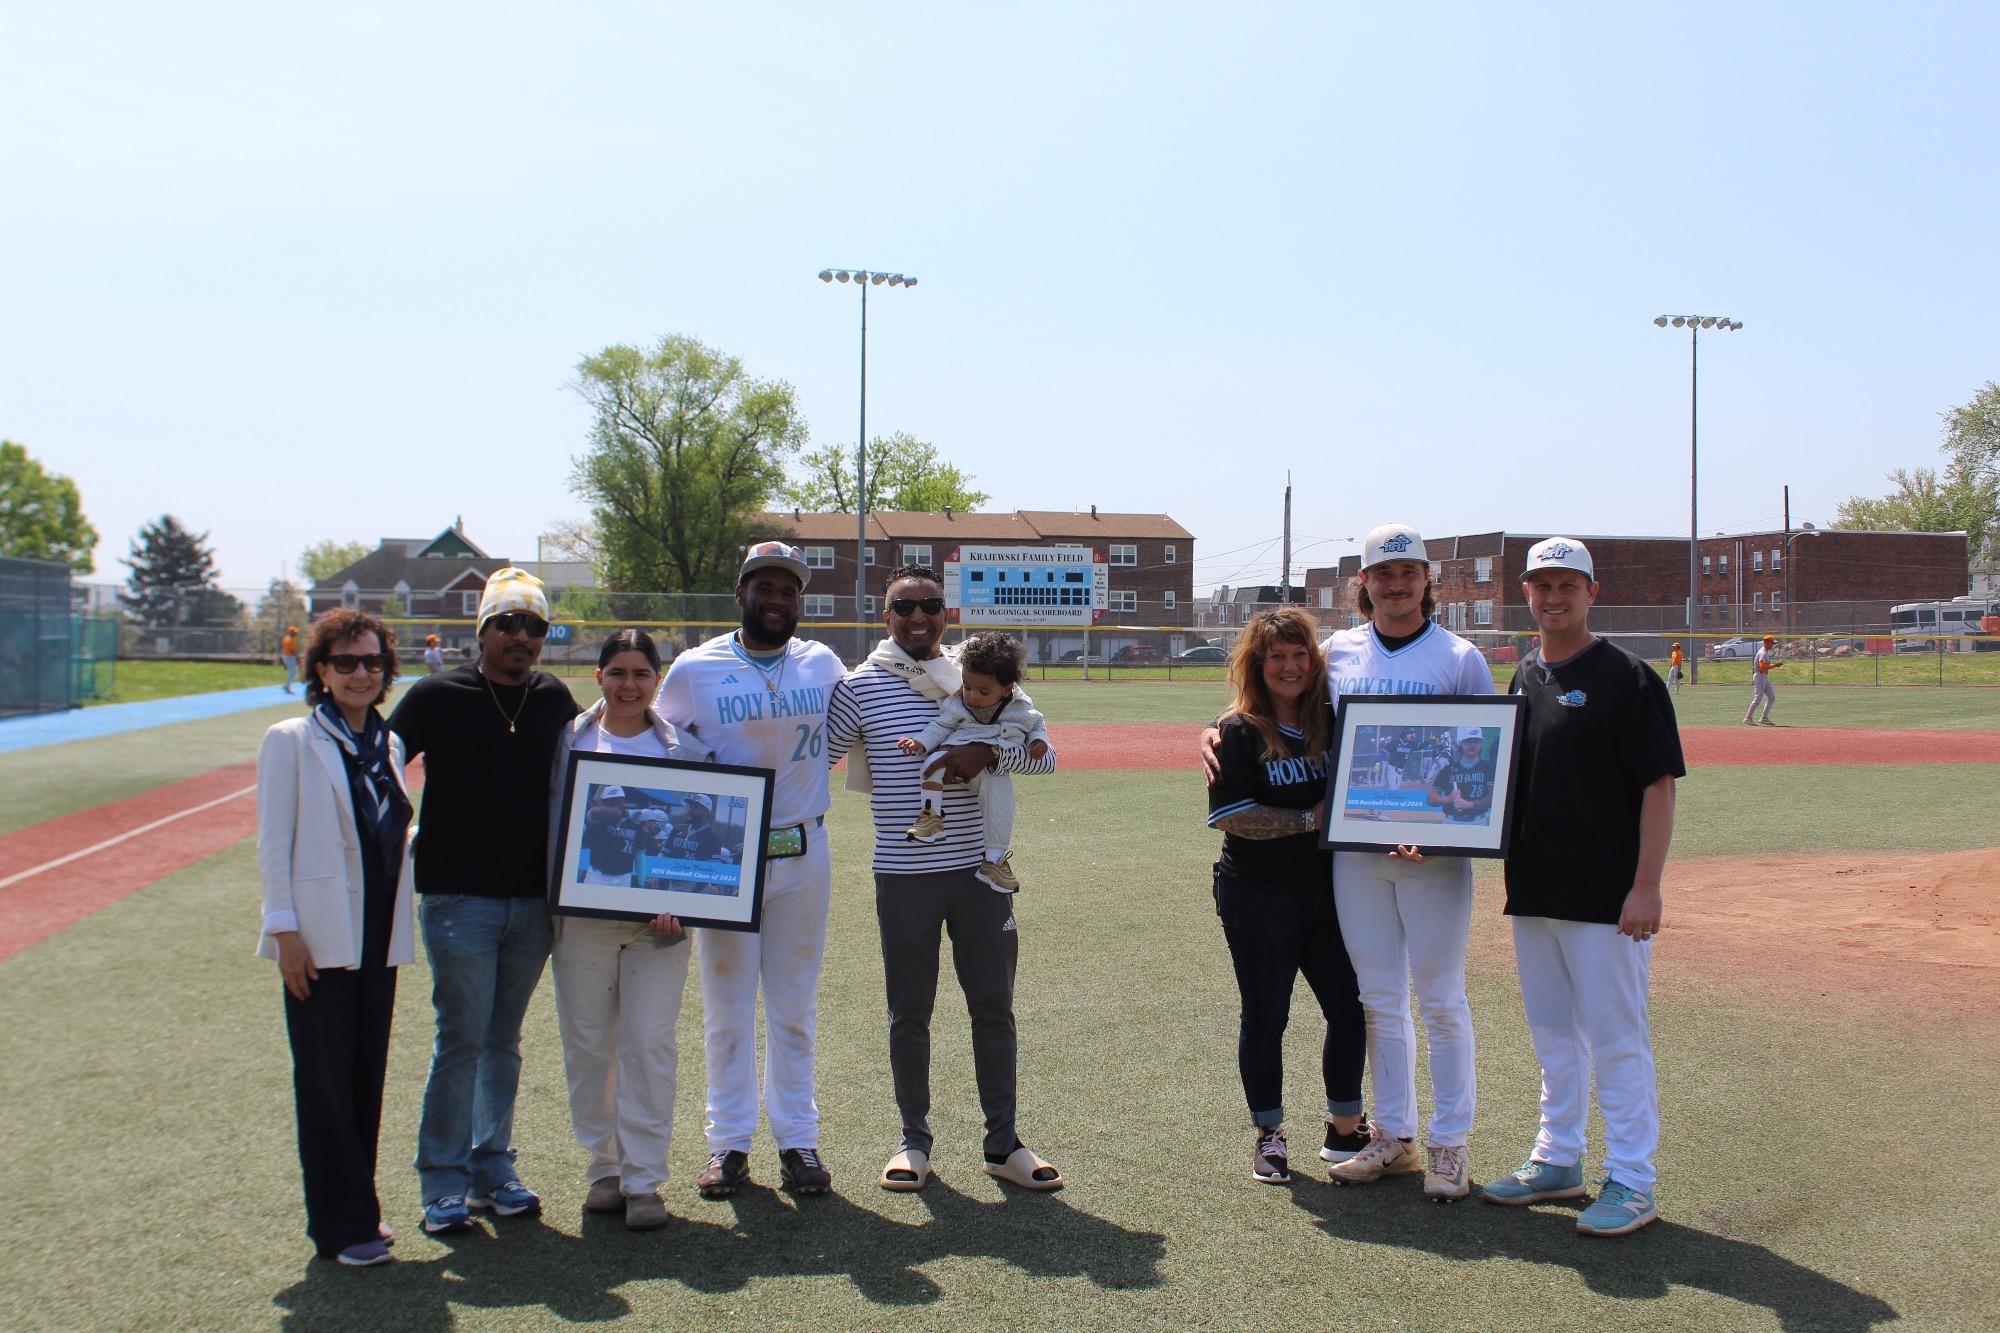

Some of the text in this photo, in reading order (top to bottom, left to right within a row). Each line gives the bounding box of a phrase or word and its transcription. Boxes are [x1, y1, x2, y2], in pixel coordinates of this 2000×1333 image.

[970, 552, 1083, 562] KRAJEWSKI FAMILY FIELD
[1033, 609, 1083, 617] SCOREBOARD
[547, 626, 565, 638] 10
[716, 687, 825, 725] HOLY FAMILY
[790, 721, 825, 763] 26
[1265, 757, 1309, 786] HOLY
[1469, 784, 1484, 798] 28
[665, 869, 693, 877] Baseball
[719, 874, 737, 882] 2024
